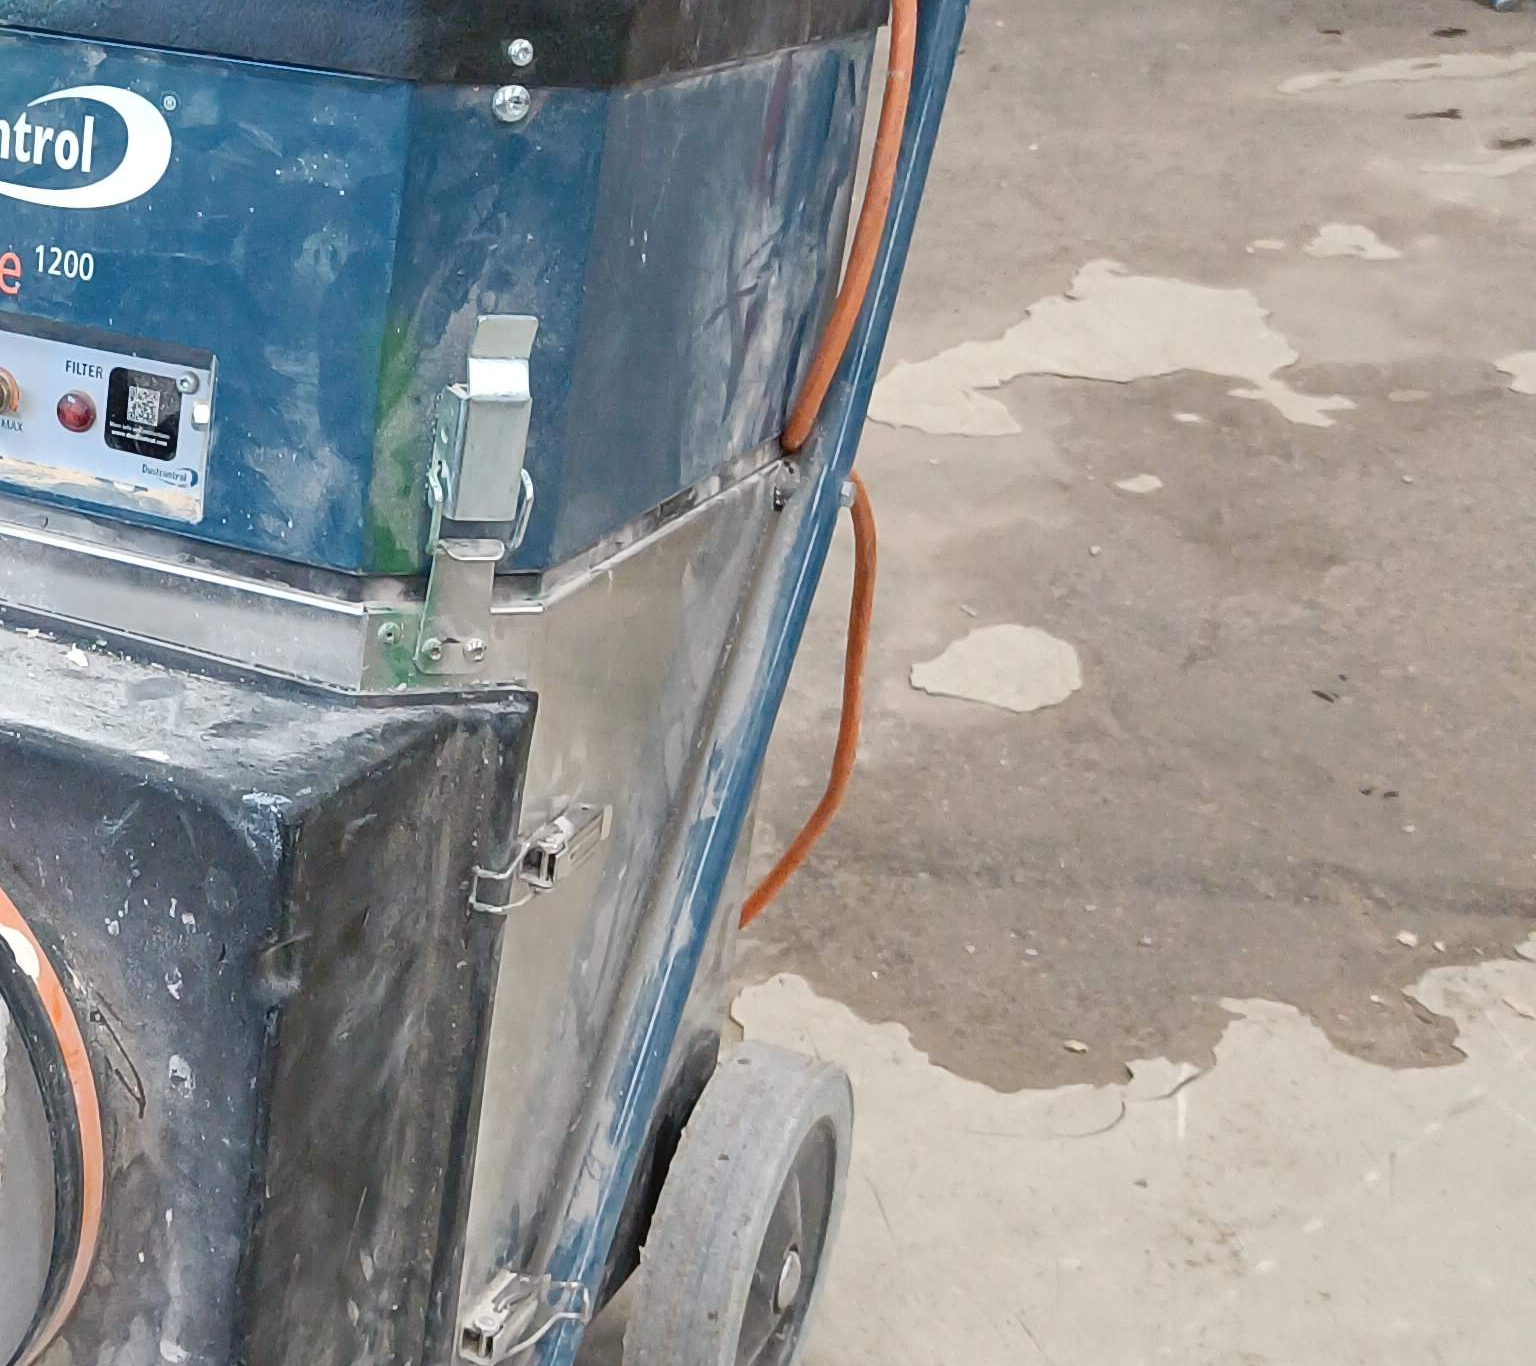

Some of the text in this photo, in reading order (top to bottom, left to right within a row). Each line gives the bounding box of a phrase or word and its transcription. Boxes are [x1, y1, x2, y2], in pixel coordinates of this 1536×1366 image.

[35, 244, 95, 282] 1200
[65, 360, 104, 380] FILTER
[0, 418, 24, 433] MAX
